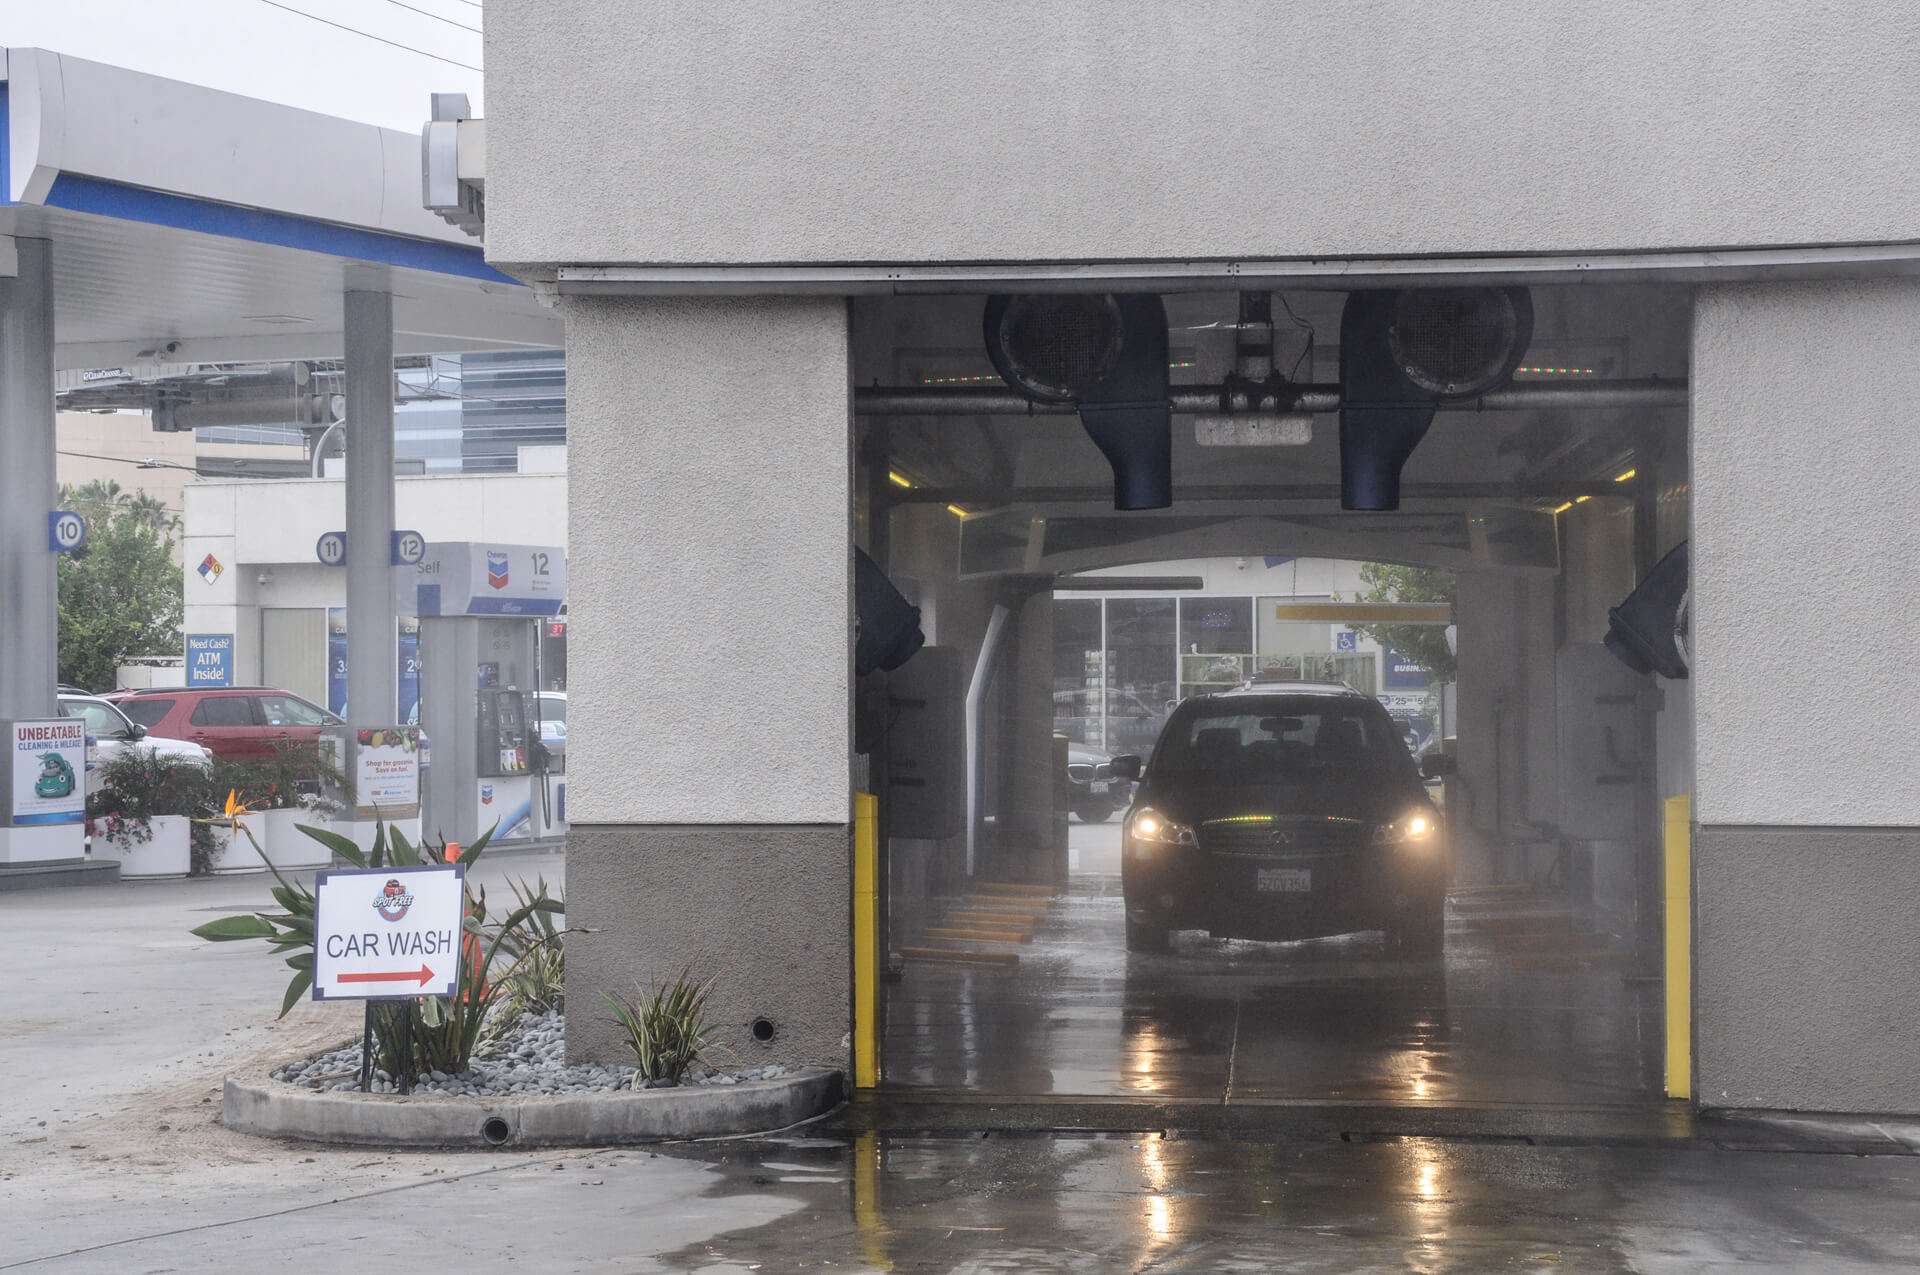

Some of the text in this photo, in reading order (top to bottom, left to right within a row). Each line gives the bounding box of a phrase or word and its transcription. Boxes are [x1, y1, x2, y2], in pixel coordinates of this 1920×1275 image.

[58, 521, 78, 540] 10
[324, 540, 338, 557] 11
[402, 540, 418, 556] 12
[417, 560, 440, 574] Self
[531, 553, 549, 575] 12
[189, 638, 229, 649] Need Cash?
[197, 652, 221, 665] ATM
[193, 667, 224, 680] Inside!
[18, 725, 81, 741] UNBEATABLE
[18, 741, 53, 751] CLEANING
[55, 741, 59, 749] &
[366, 760, 382, 768] Shop
[372, 894, 414, 908] SPOT FREE
[326, 930, 451, 958] CAR WASH
